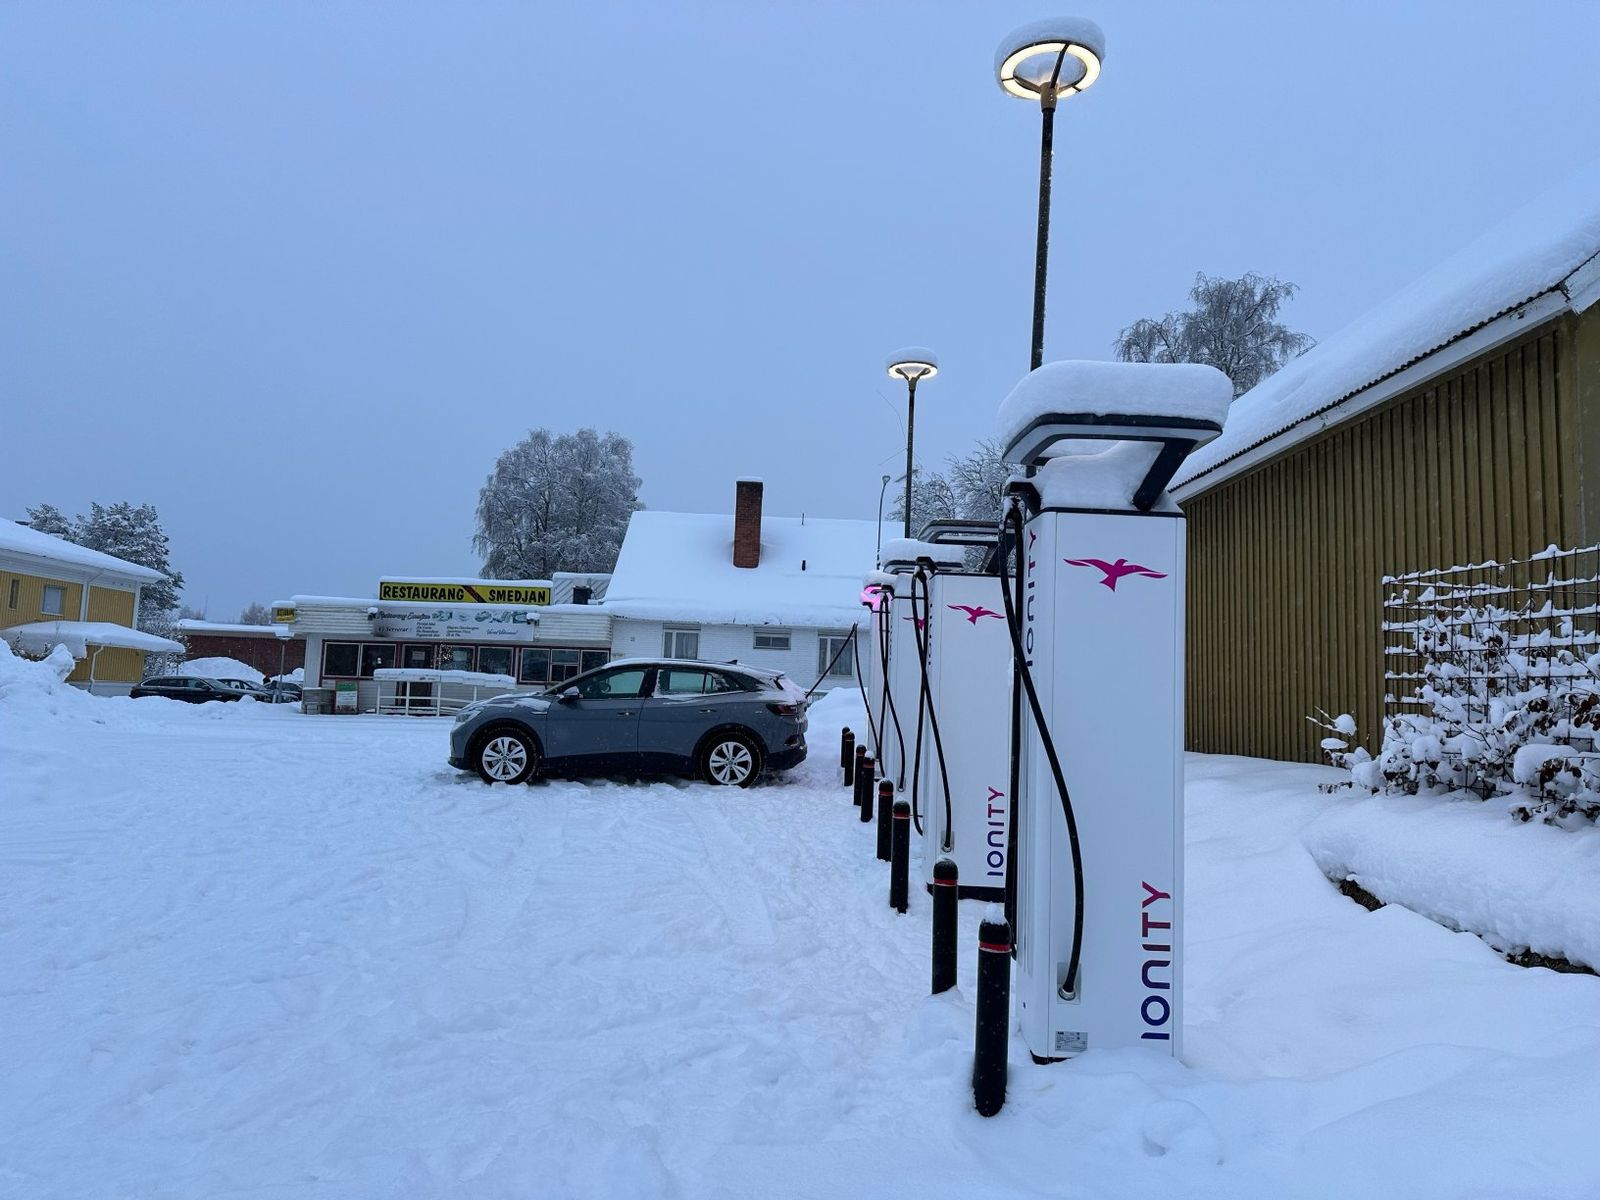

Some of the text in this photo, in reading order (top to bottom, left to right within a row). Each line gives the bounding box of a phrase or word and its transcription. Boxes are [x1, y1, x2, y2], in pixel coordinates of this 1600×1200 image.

[383, 585, 546, 603] RESTAURANG SMEDJAN
[986, 785, 1005, 877] IONITY
[1140, 880, 1171, 1040] IONITY
